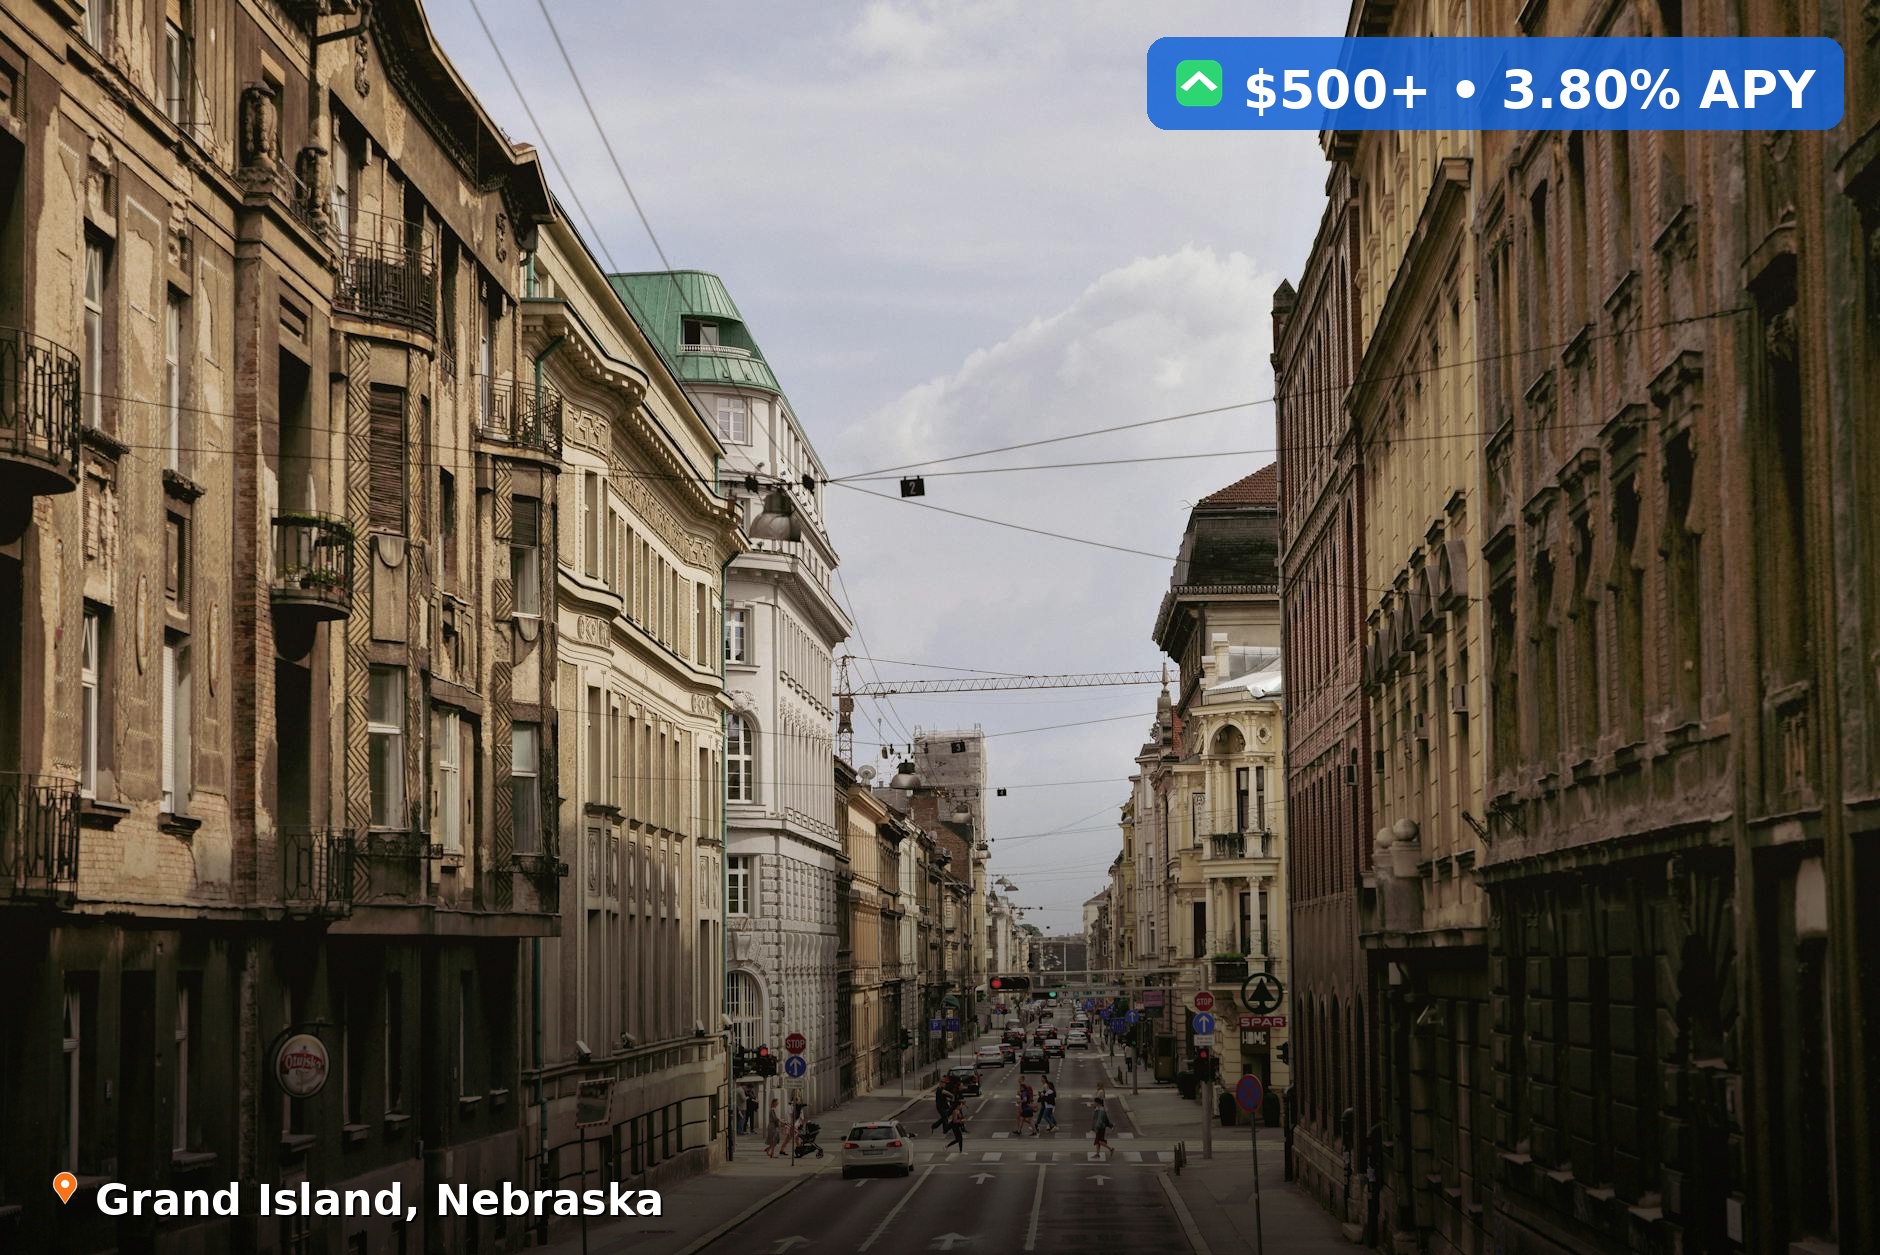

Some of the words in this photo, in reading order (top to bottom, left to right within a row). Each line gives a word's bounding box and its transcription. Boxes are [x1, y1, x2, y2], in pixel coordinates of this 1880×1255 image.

[909, 481, 916, 495] 2
[1196, 997, 1213, 1006] STOP
[1240, 1017, 1284, 1027] SPAR
[786, 1039, 805, 1049] STOP
